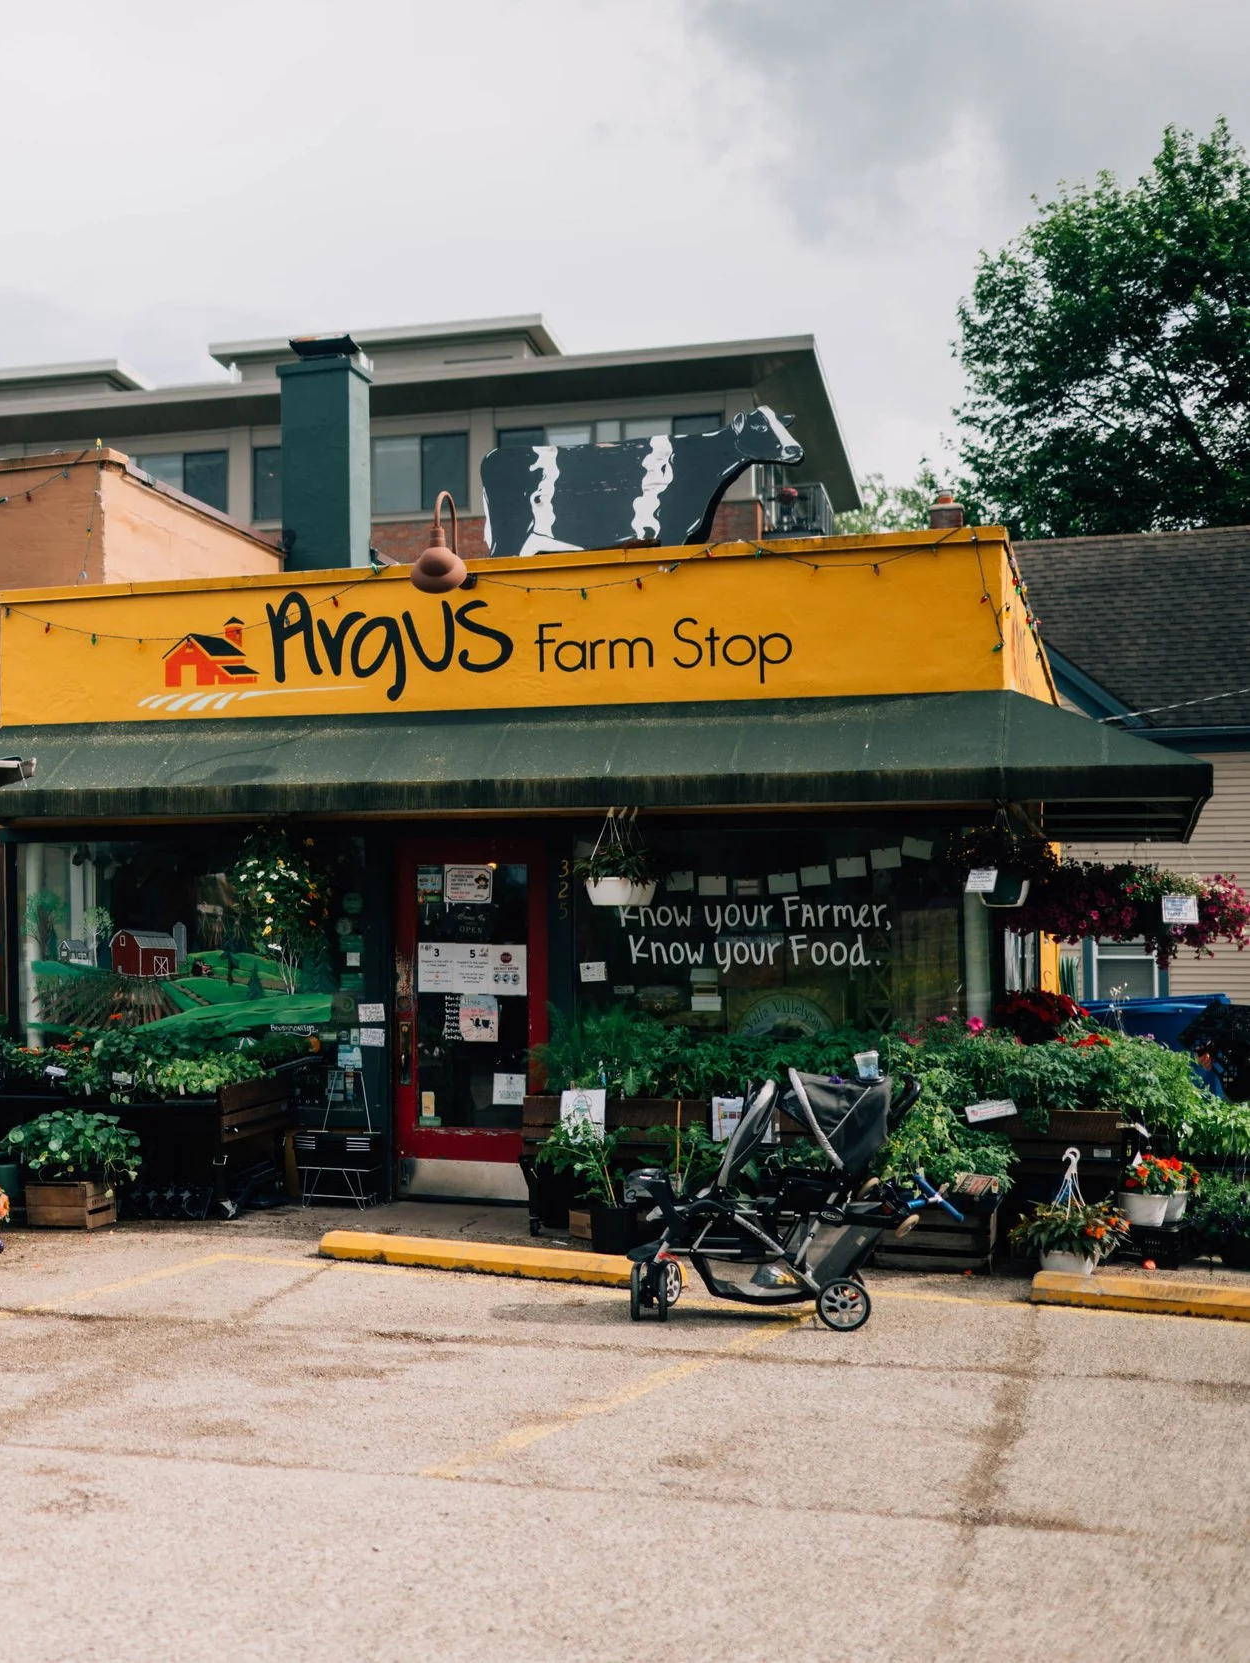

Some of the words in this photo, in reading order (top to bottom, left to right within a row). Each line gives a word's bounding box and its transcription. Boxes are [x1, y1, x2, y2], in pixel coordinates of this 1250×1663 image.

[534, 622, 654, 673] Farm
[673, 617, 793, 684] Stop
[619, 904, 692, 928] Know
[703, 903, 774, 934] your
[459, 925, 483, 935] OPEN
[433, 948, 440, 958] 3
[469, 949, 476, 959] 5
[628, 934, 705, 965] Know
[713, 940, 781, 974] your
[789, 933, 883, 967] Food.
